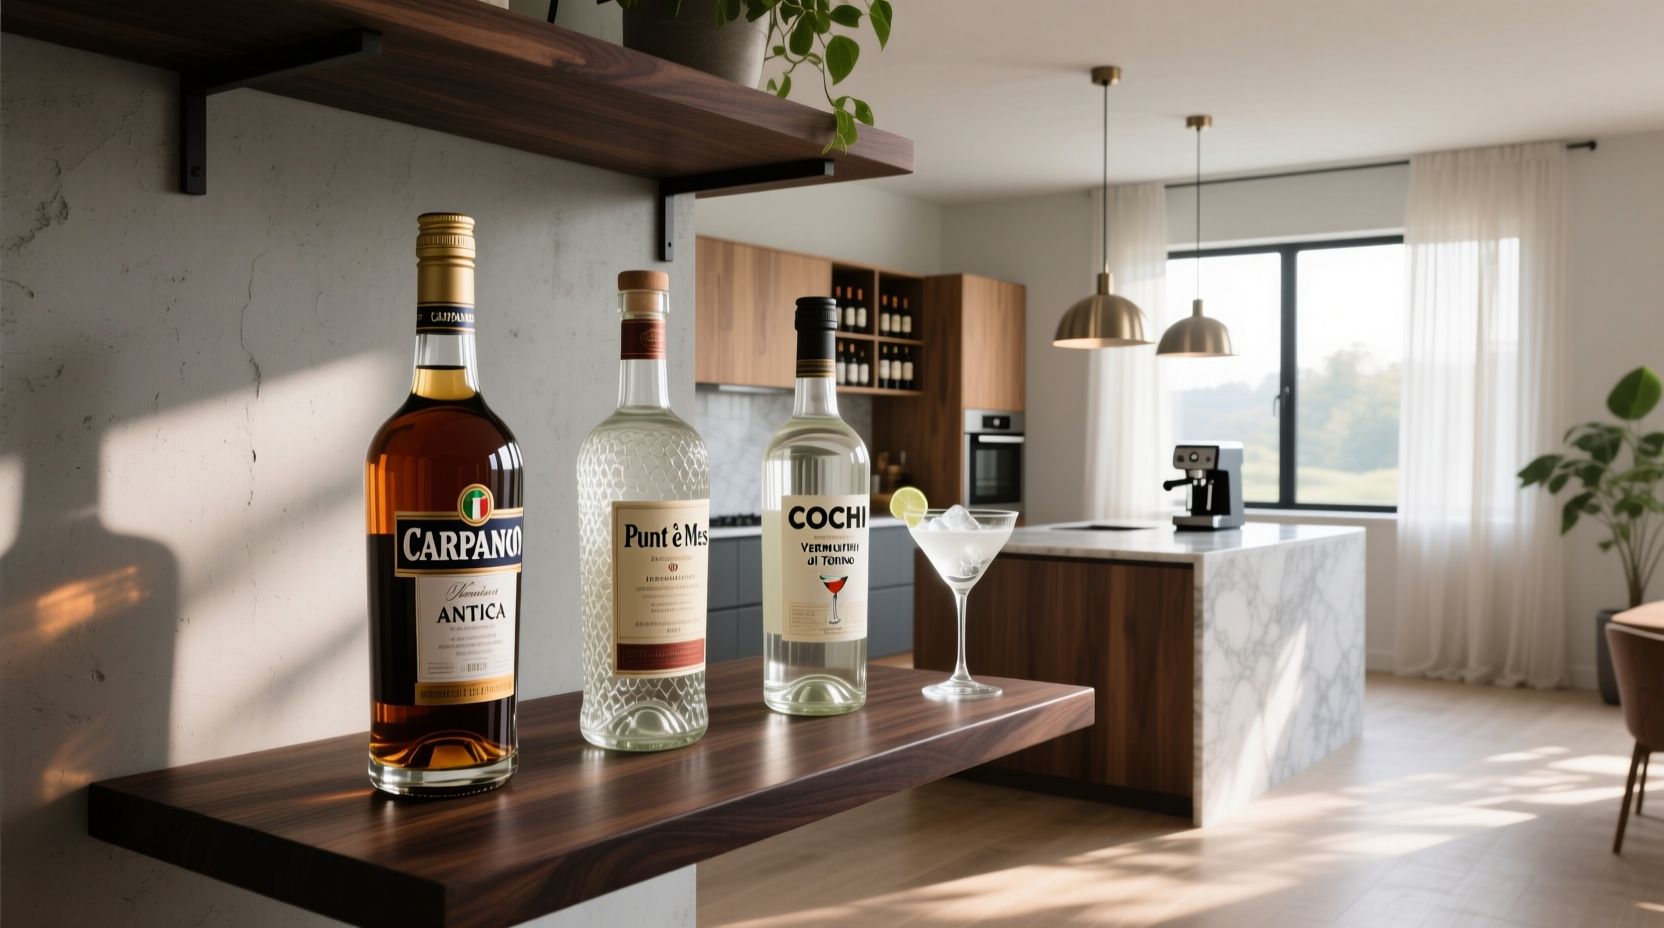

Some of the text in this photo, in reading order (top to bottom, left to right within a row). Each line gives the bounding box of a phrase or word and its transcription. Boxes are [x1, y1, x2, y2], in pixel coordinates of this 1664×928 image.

[788, 505, 866, 530] COCHI
[624, 523, 668, 548] Punt
[436, 602, 506, 624] ANTICA
